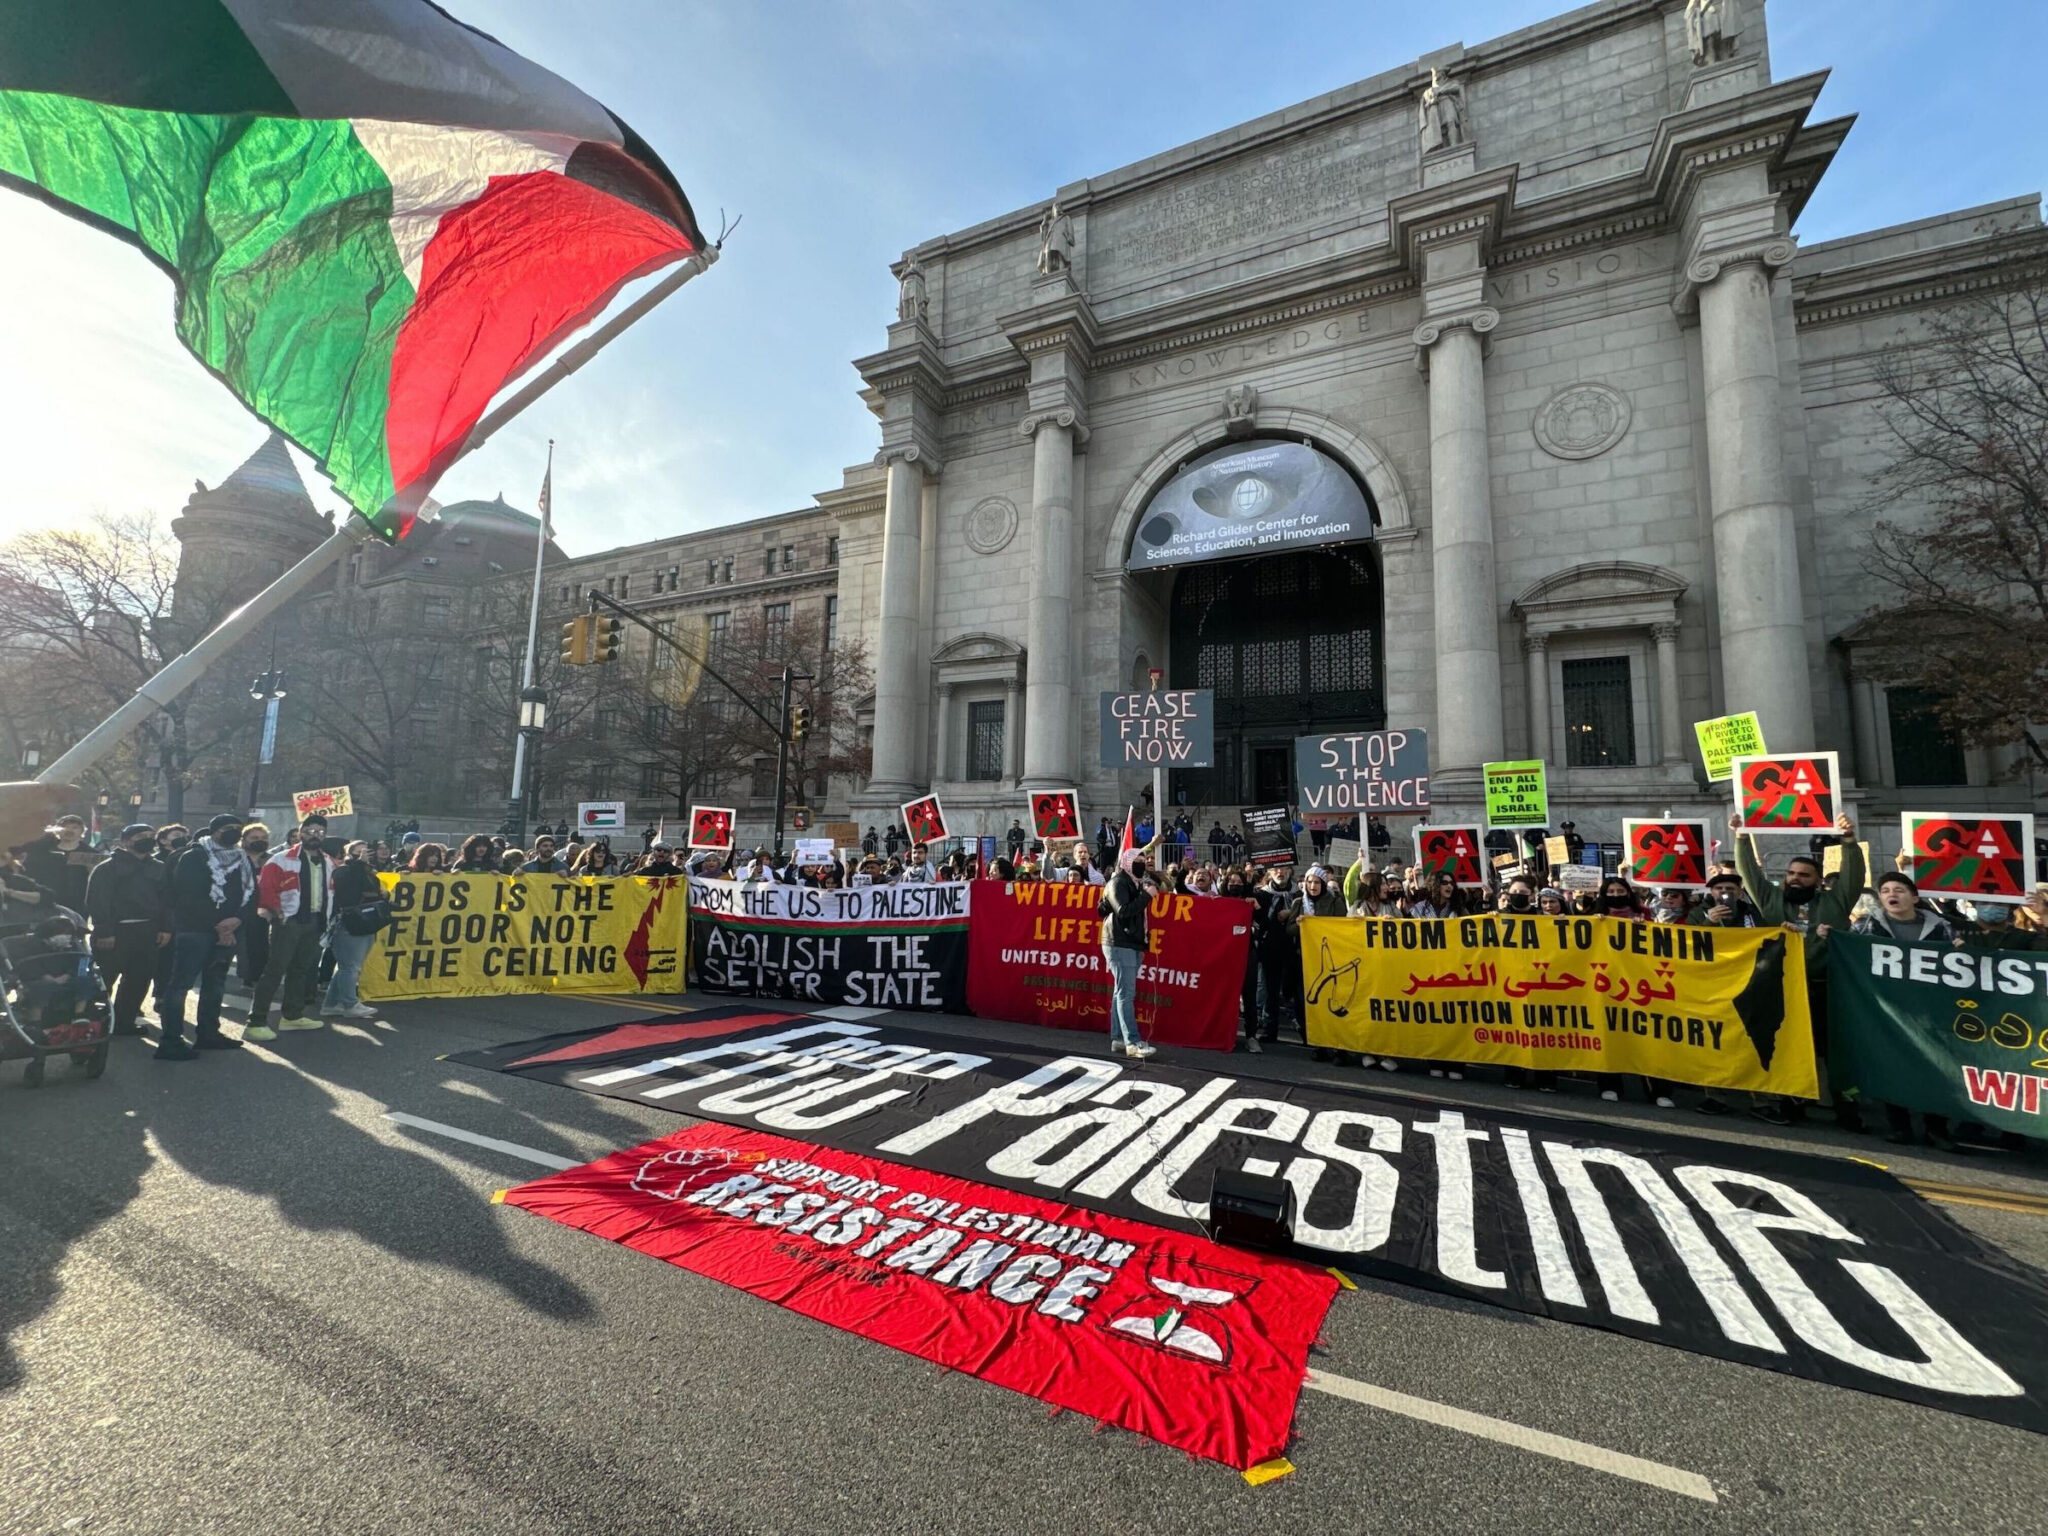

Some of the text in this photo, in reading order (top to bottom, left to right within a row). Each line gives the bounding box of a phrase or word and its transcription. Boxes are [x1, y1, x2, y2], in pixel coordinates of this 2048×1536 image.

[1490, 243, 1662, 299] VISION
[1128, 309, 1371, 390] KNOWLEDGE
[1146, 521, 1350, 561] Science, Education, and Innovation
[1173, 513, 1319, 545] Richard Gilder Center for
[1111, 691, 1198, 718] CEASE
[1120, 719, 1186, 740] FIRE
[1711, 717, 1752, 731] FROM THE
[1715, 725, 1754, 738] RIVER TO
[1125, 739, 1193, 763] NOW
[1319, 732, 1408, 769] STOP
[1707, 741, 1759, 758] PALESTINE
[1720, 736, 1736, 746] THE
[1336, 767, 1382, 782] THE
[1489, 774, 1537, 785] END ALL
[1490, 784, 1538, 794] U.S. AID
[1304, 776, 1431, 809] VIOLENCE
[1496, 804, 1540, 813] ISRAEL
[1509, 794, 1524, 803] TO
[392, 881, 615, 912] BDS IS THE
[691, 883, 734, 914] FROM
[741, 889, 779, 917] THE
[835, 892, 863, 919] TO
[871, 886, 966, 919] PALESTINE
[1014, 882, 1195, 922] WITHI UR
[387, 914, 597, 947] FLOOR NOT
[1366, 918, 1715, 962] FROM GAZA TO JENIN
[384, 945, 616, 982] THE CEILING
[867, 935, 931, 970] THE
[1001, 948, 1061, 967] UNITED
[1065, 953, 1099, 971] FOR
[843, 970, 943, 1006] STATE
[1401, 961, 1677, 1007] ثورة حتى النصر
[1368, 997, 1725, 1051] REVOLUTION UNTIL VICTORY
[1474, 1027, 1603, 1052] @wolpalestine
[752, 1157, 900, 1203] SUPPORT
[889, 1191, 1137, 1269] PALESTINIAN
[683, 1173, 1114, 1323] RESISTANCE
